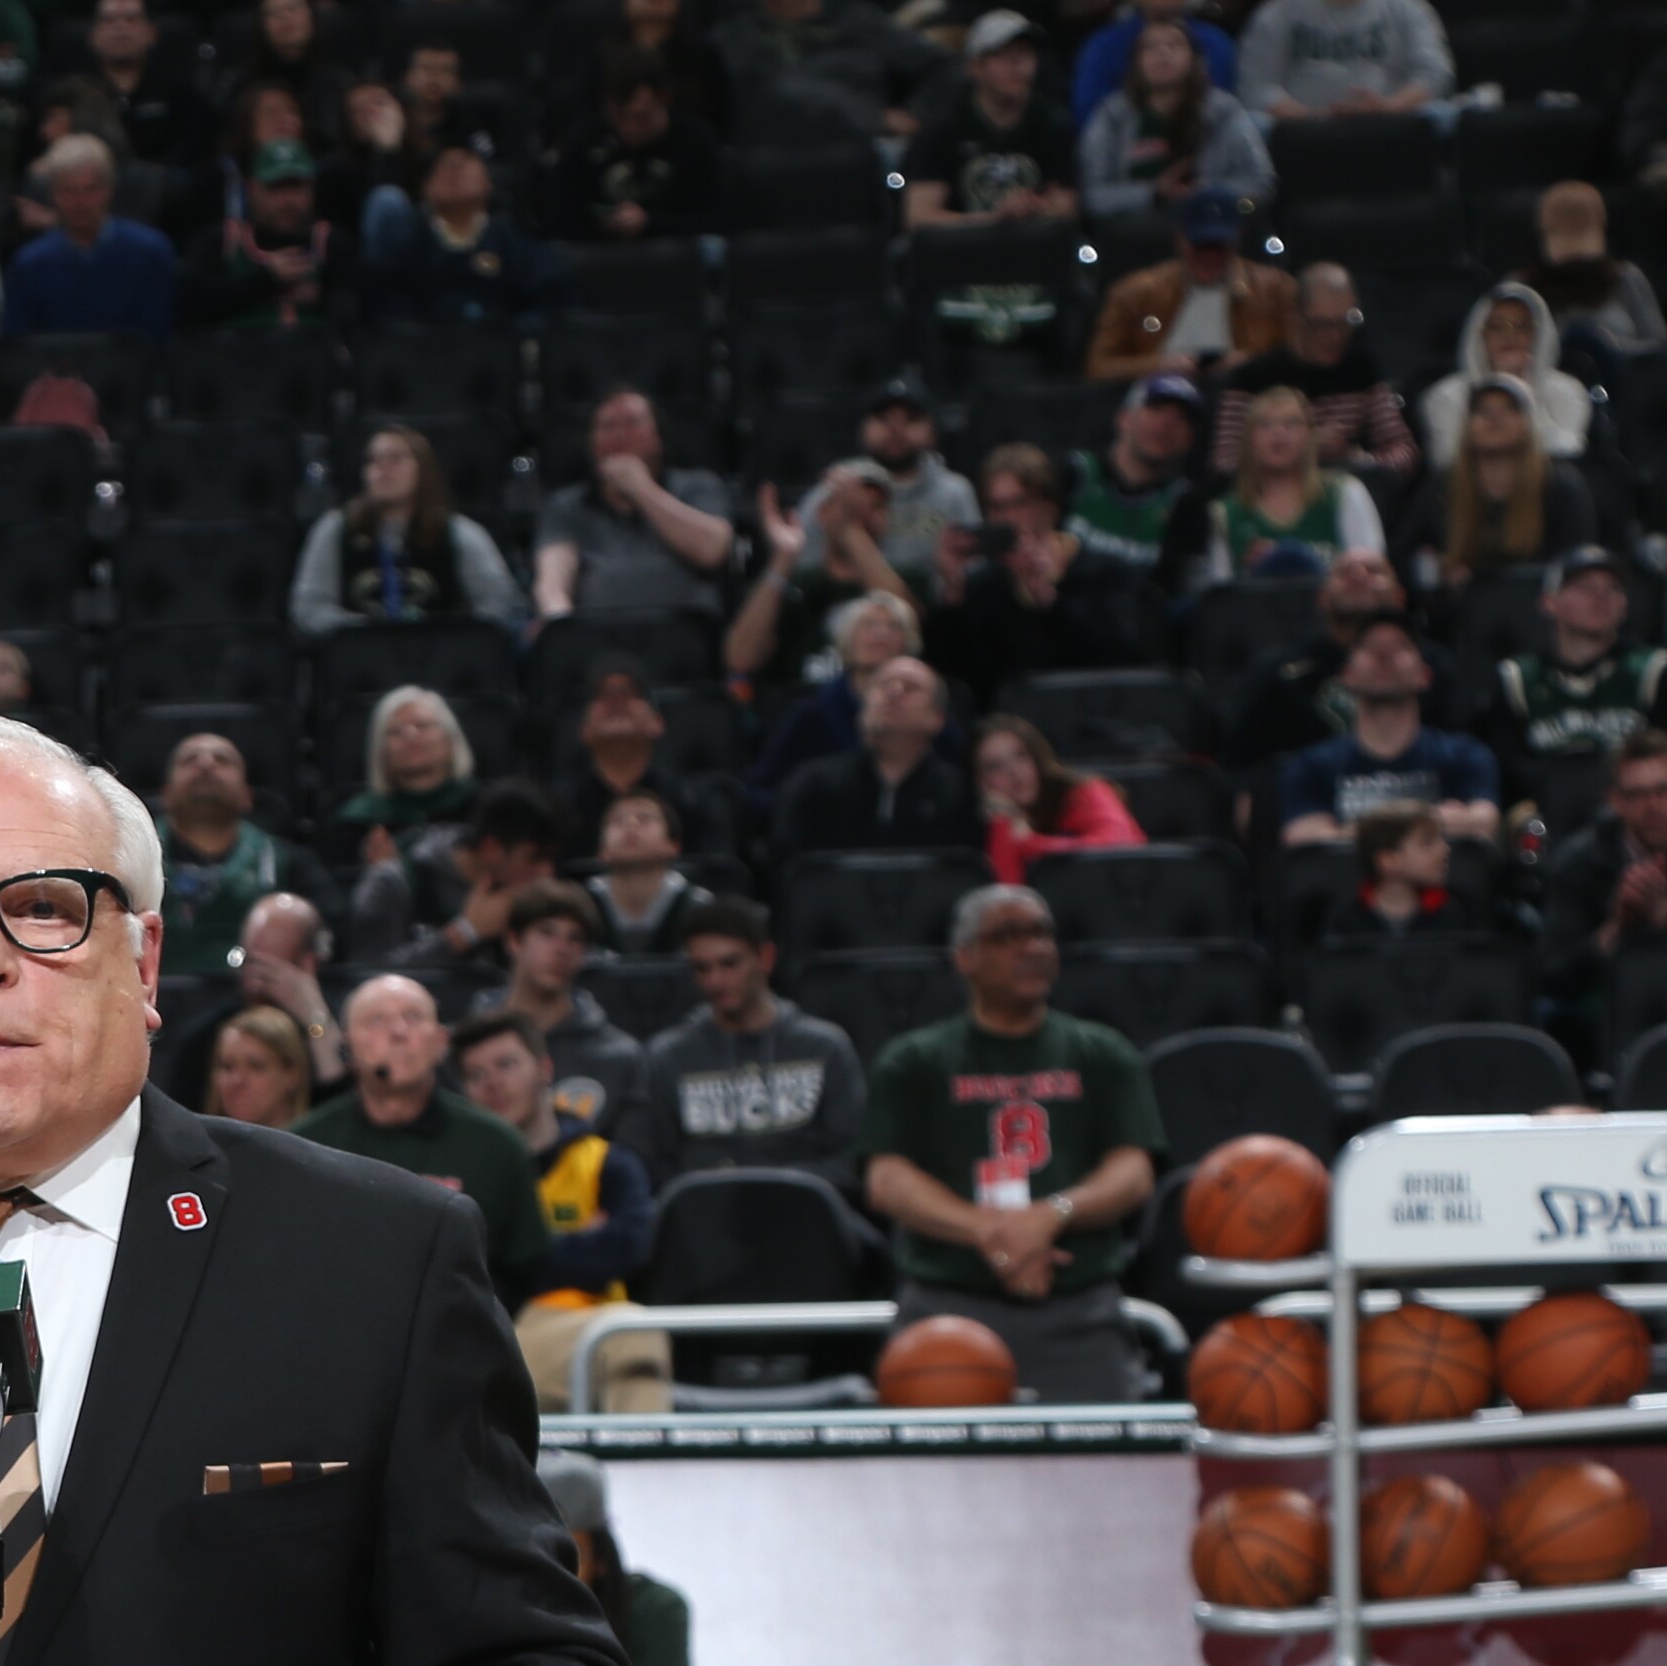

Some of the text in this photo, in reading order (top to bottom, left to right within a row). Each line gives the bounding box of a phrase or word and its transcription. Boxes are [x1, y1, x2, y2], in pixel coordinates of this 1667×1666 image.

[682, 1090, 819, 1135] BUCKS
[1403, 1170, 1472, 1195] OFFICIAL
[167, 1191, 208, 1231] 8
[1393, 1200, 1483, 1225] GAME BALL
